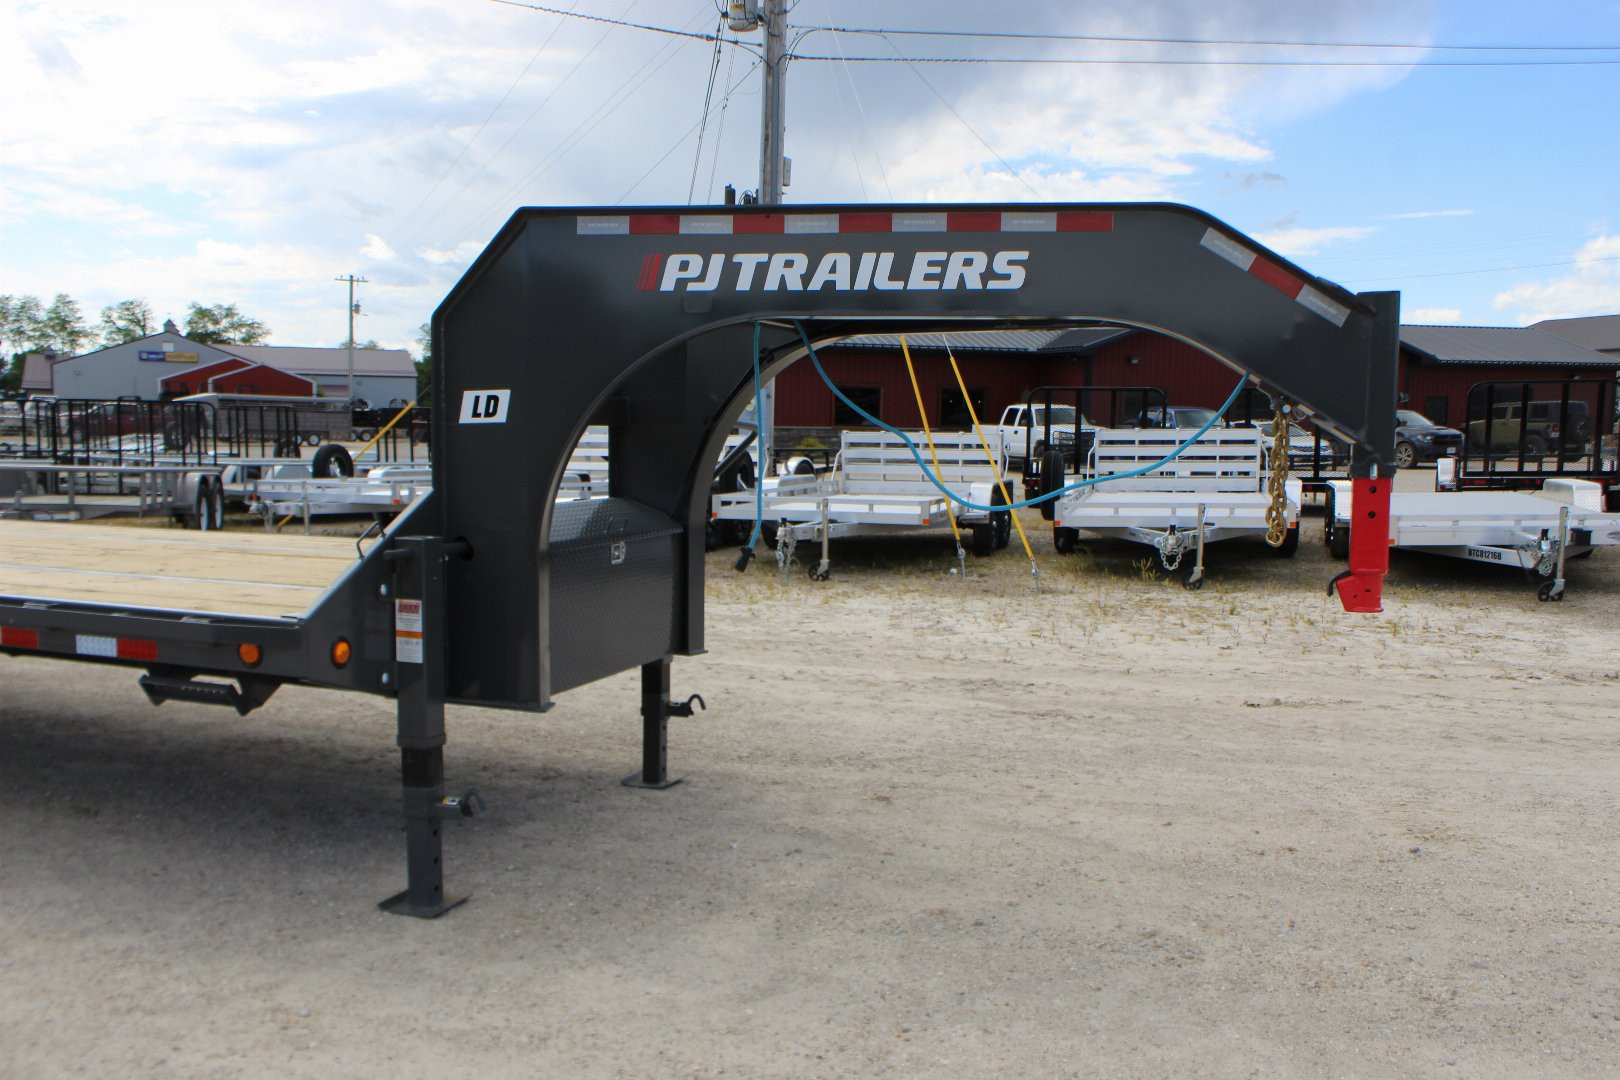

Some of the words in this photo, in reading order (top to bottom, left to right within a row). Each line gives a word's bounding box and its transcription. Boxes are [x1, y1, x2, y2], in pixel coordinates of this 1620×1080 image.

[660, 253, 726, 292] PJ
[732, 250, 1030, 292] TRAILERS
[471, 394, 500, 418] LD
